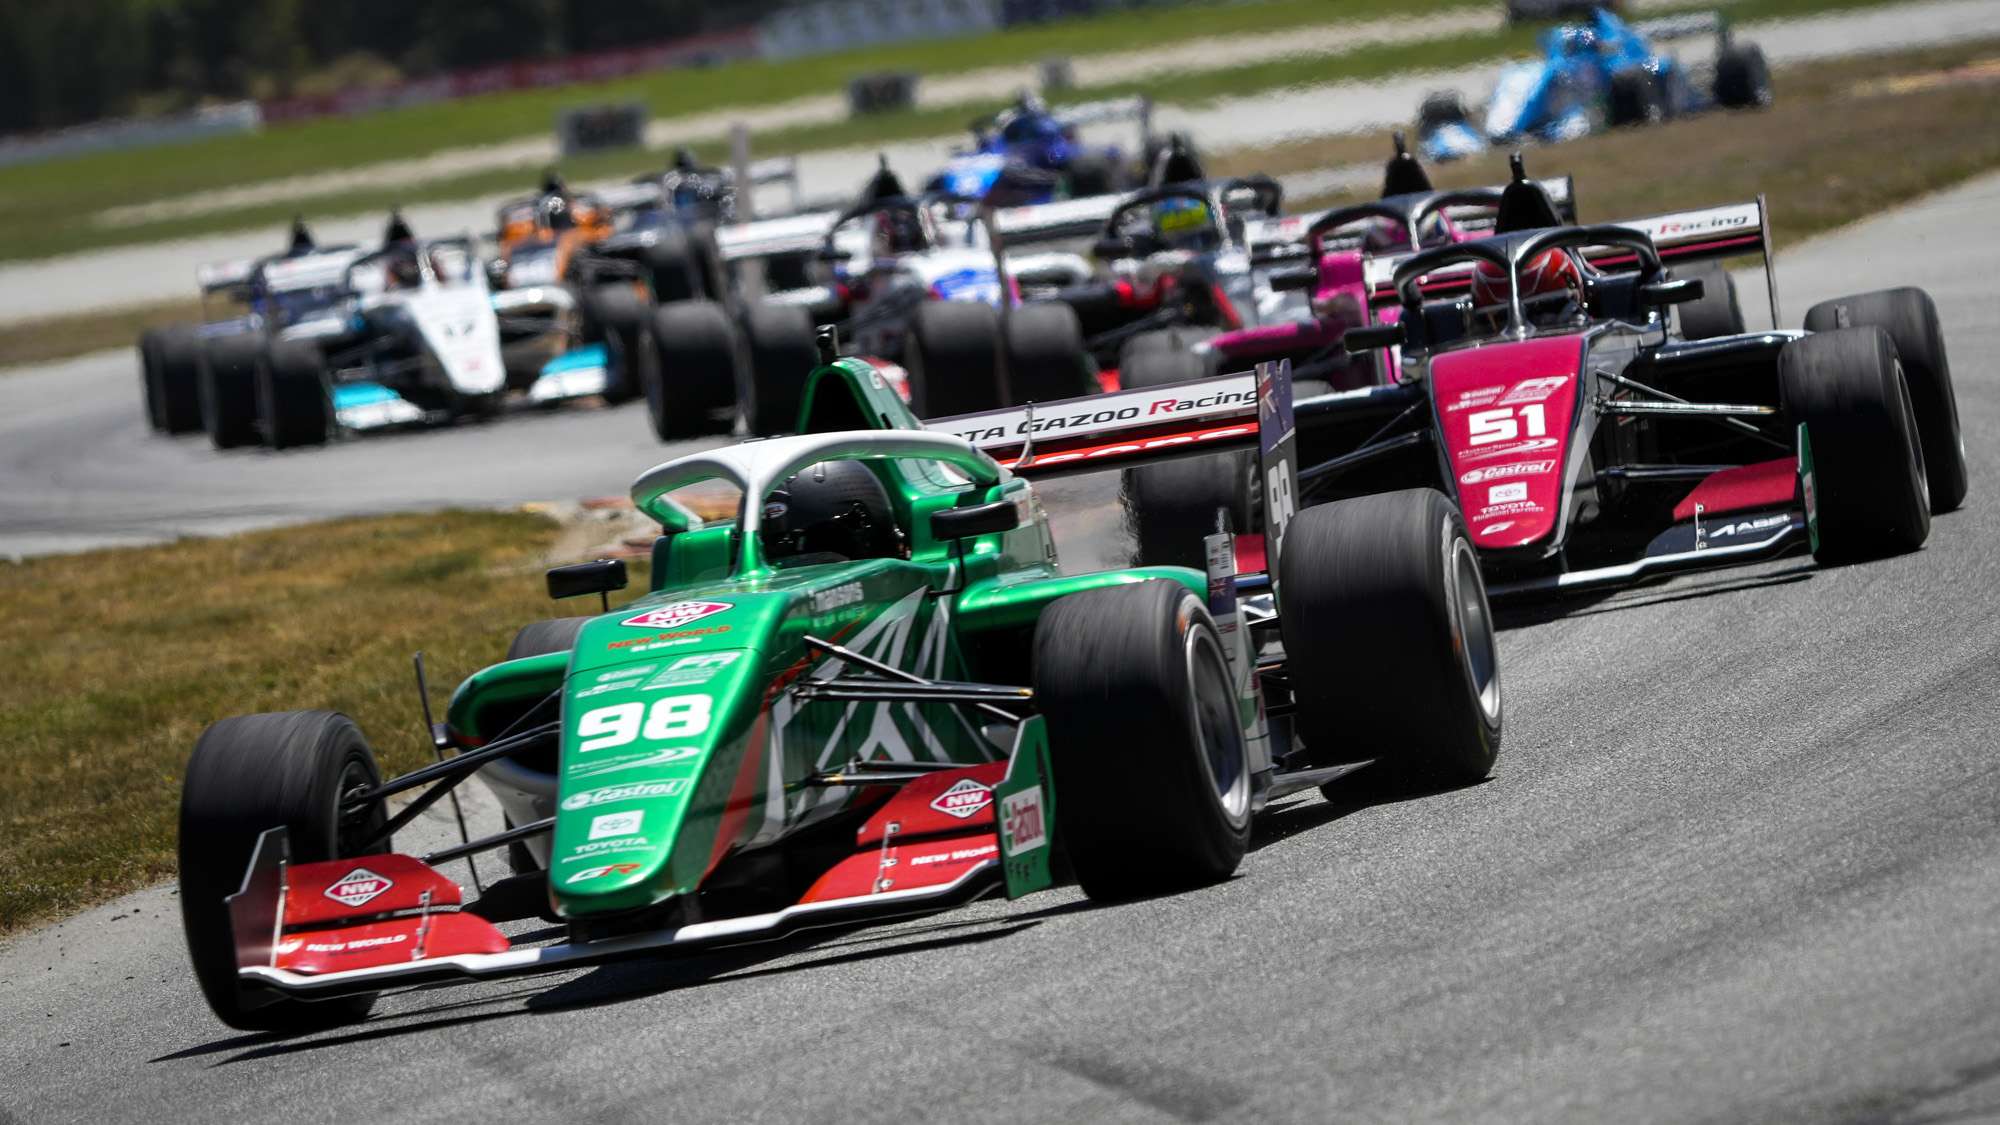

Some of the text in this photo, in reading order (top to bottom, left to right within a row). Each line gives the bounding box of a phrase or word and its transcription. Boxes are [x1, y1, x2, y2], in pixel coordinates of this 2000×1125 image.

[952, 390, 1258, 442] TA GAZOO Racing
[1469, 403, 1545, 446] 51
[1484, 462, 1546, 480] Castrol
[1480, 501, 1536, 514] TOYOTA
[647, 604, 710, 622] NW
[607, 625, 732, 651] NEW WORLD
[577, 694, 712, 752] 98
[592, 780, 677, 803] Castrol
[946, 791, 984, 808] NW
[575, 837, 648, 854] TOYOTA
[911, 853, 950, 866] NEW
[951, 845, 998, 860] WORL
[340, 880, 377, 896] NW
[306, 941, 346, 953] NEW
[348, 934, 408, 949] WORLD
